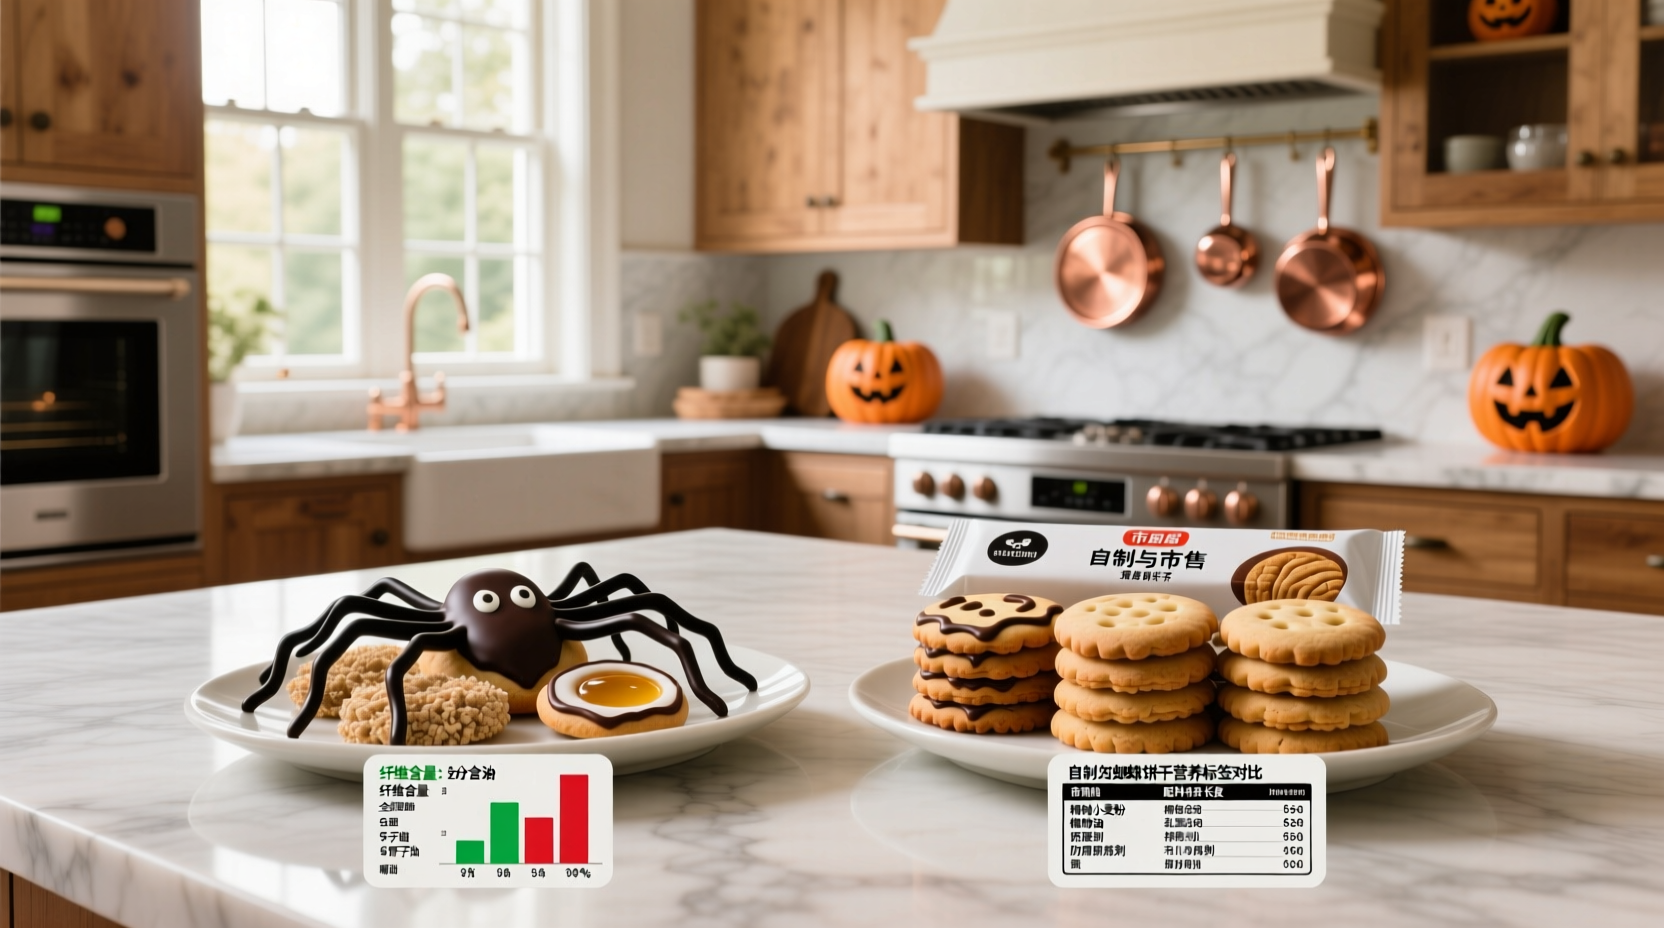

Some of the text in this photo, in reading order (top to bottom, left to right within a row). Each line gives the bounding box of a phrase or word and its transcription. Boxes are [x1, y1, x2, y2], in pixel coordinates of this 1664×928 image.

[1090, 548, 1207, 570] 自制与市售
